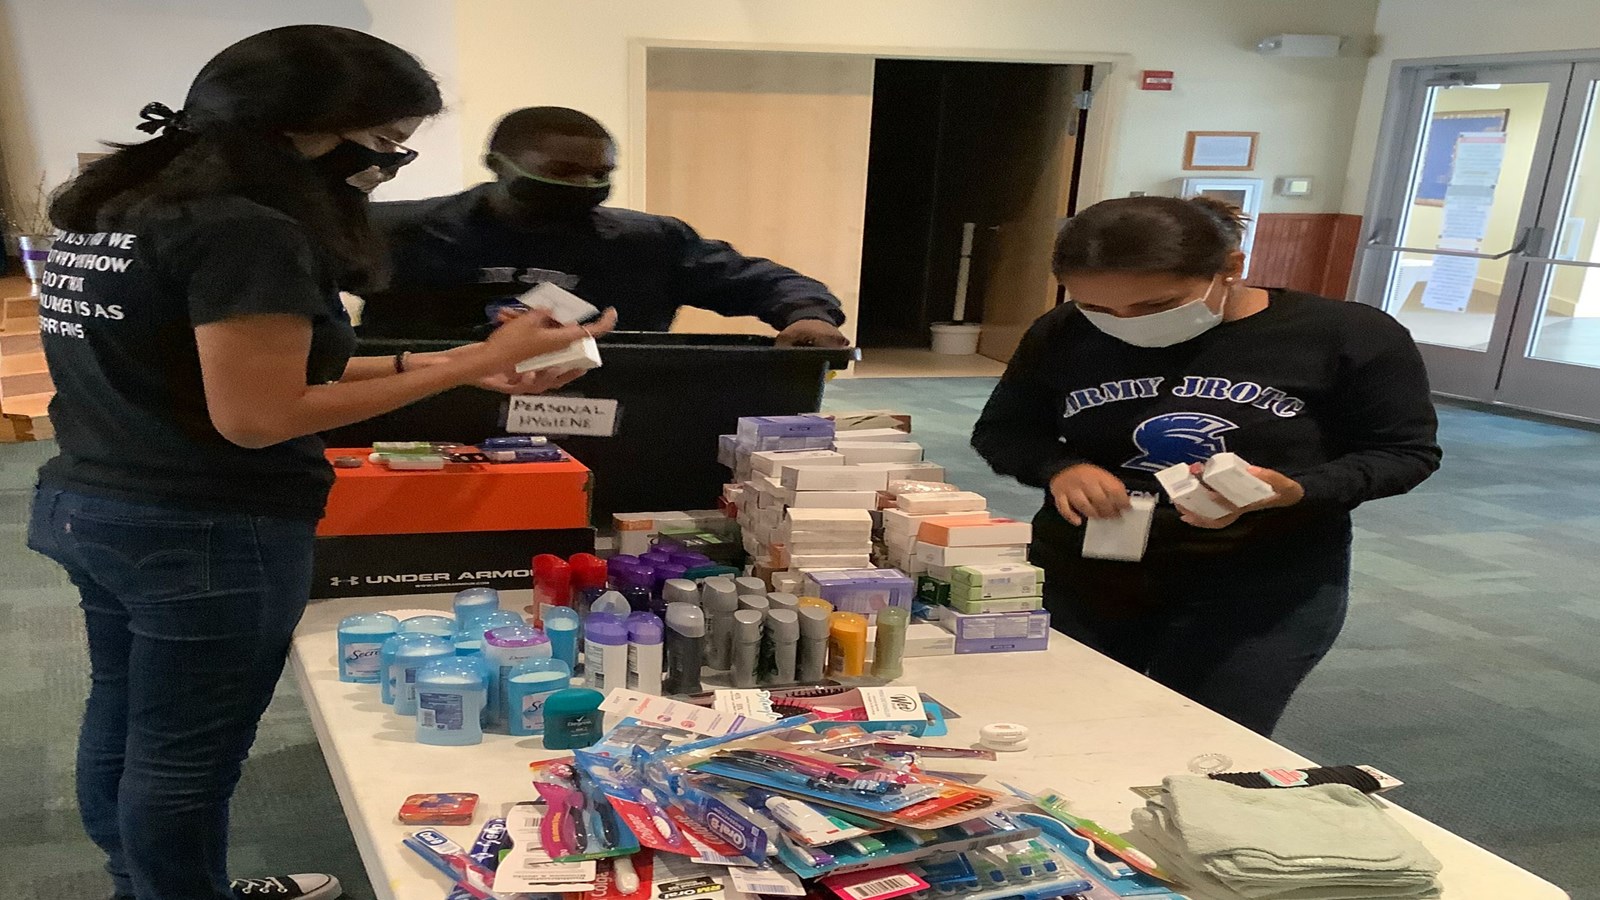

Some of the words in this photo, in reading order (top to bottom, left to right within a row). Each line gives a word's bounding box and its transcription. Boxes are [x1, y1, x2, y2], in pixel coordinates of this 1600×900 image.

[108, 232, 137, 250] WE
[94, 303, 125, 320] AS
[1063, 376, 1165, 418] ARMY
[1173, 376, 1304, 417] JROTC
[513, 400, 605, 415] PERSONAL
[519, 415, 593, 430] HYGIENE
[365, 572, 451, 584] UNDER
[710, 817, 745, 847] Oral-B
[664, 889, 696, 900] Oral
